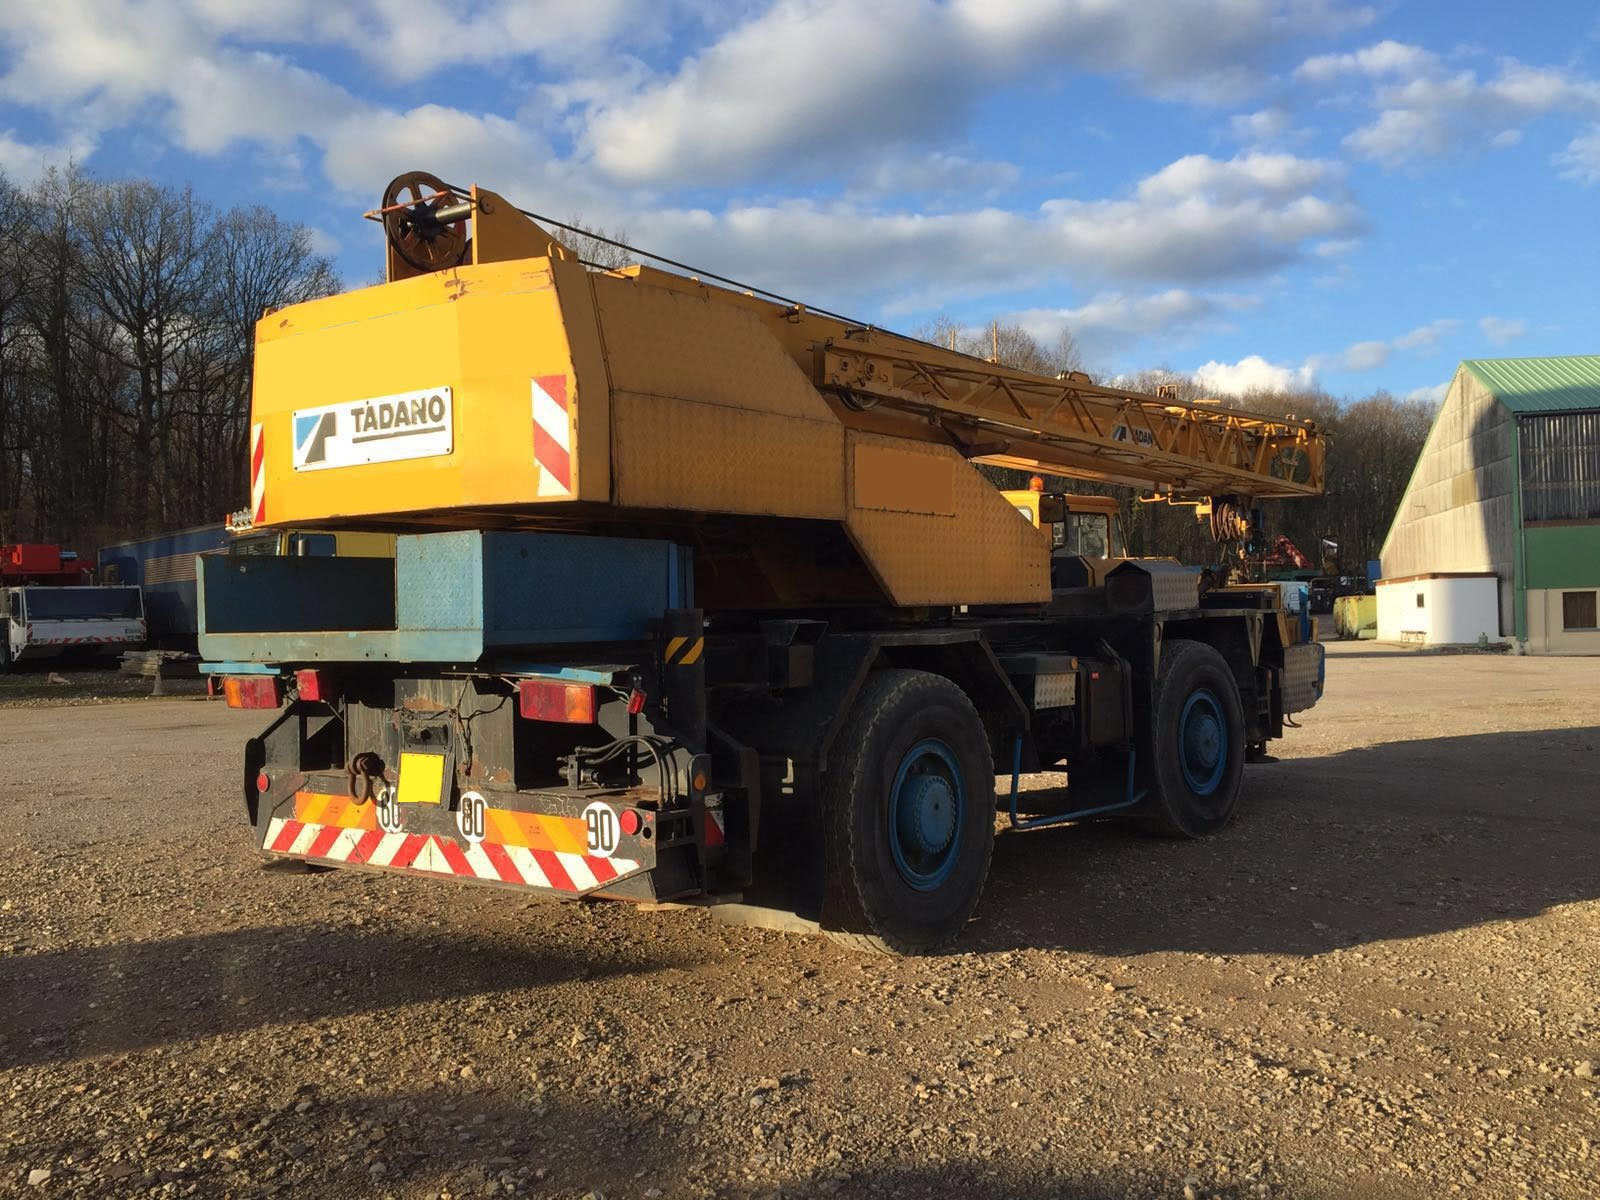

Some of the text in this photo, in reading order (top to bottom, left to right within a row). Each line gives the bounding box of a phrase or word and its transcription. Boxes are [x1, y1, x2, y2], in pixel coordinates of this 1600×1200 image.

[351, 395, 445, 432] TADANO
[462, 798, 484, 837] 80
[586, 809, 613, 851] 90
